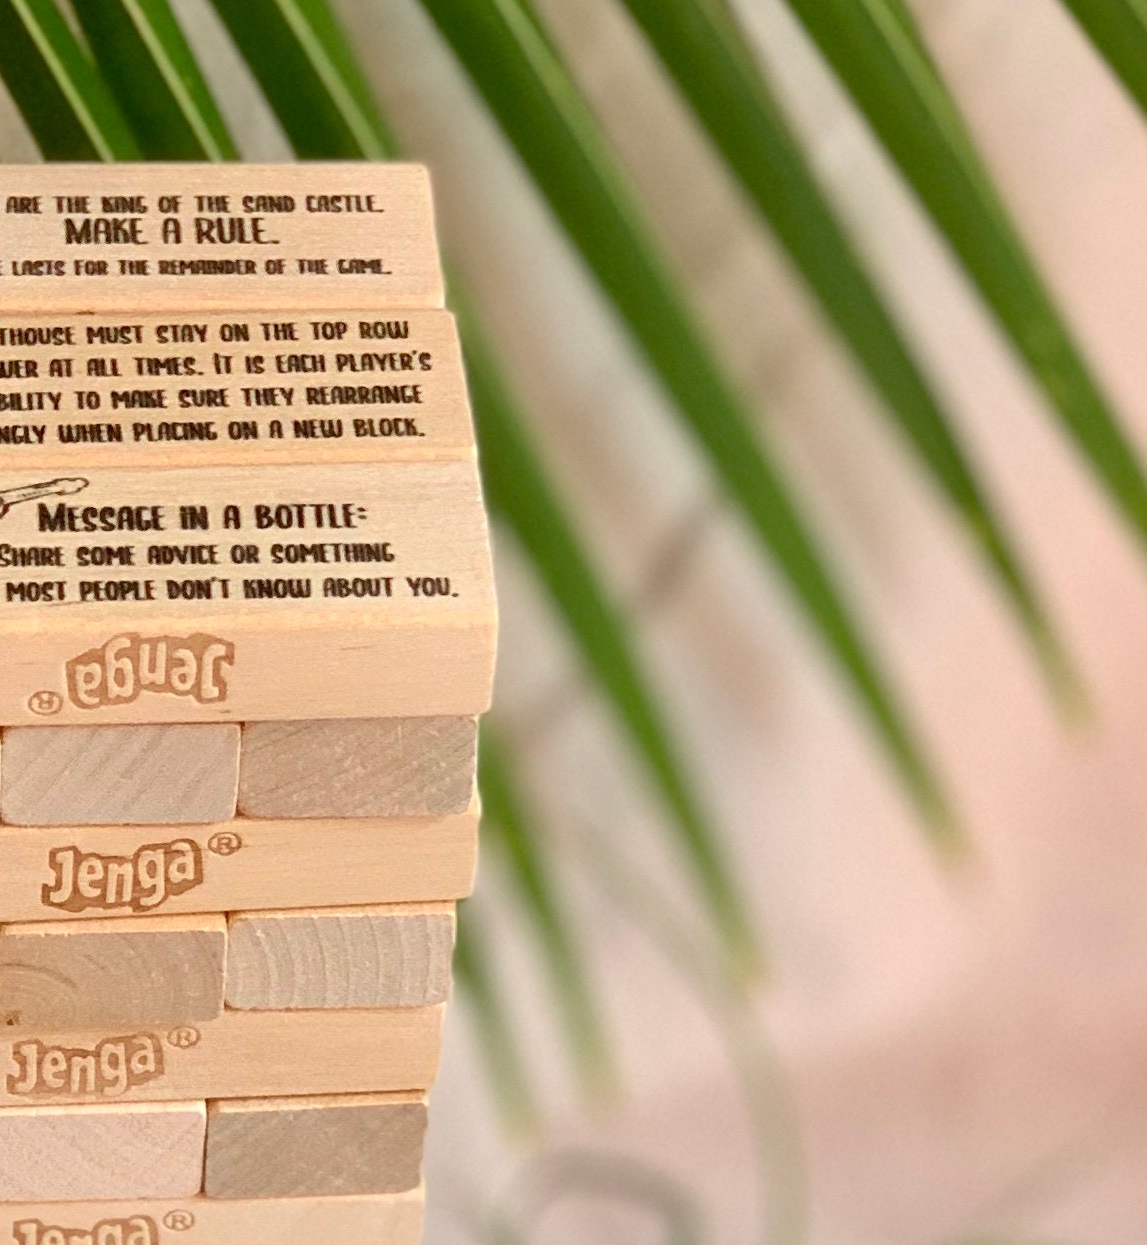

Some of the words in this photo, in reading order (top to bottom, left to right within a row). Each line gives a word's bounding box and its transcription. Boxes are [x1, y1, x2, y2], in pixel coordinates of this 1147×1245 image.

[6, 195, 42, 214] ARE
[54, 195, 90, 214] THE
[100, 195, 148, 214] KING
[157, 195, 182, 214] OF
[194, 195, 230, 213] THE
[241, 195, 296, 213] SAND
[64, 217, 148, 245] MAKE
[162, 217, 182, 245] A
[12, 259, 66, 277] LASTS
[73, 259, 109, 276] FOR
[118, 259, 150, 276] THE
[158, 259, 257, 276] REMAINDER
[264, 259, 285, 276] OF
[296, 258, 329, 276] THE
[86, 325, 143, 345] MUST
[155, 324, 208, 344] STAY
[219, 323, 250, 342] ON
[260, 322, 299, 342] THE
[309, 321, 348, 341] TOP
[358, 320, 409, 340] ROW
[49, 358, 74, 378] AT
[86, 357, 122, 377] ALL
[213, 352, 233, 375] IT
[245, 355, 265, 375] IS
[275, 354, 326, 374] EACH
[73, 390, 101, 410] TO
[110, 389, 168, 410] MAKE
[177, 388, 229, 409] SURE
[240, 387, 294, 407] THEY
[305, 384, 423, 406] REARRANGE
[57, 423, 123, 444] WHEN
[132, 421, 218, 442] PLACING
[227, 420, 259, 441] ON
[268, 419, 284, 439] A
[292, 418, 343, 439] NEW
[37, 502, 166, 533] MESSAGE
[179, 505, 209, 531] IN
[223, 504, 241, 530] A
[76, 545, 135, 567] SOME
[147, 544, 220, 565] ADVICE
[230, 544, 260, 565] OR
[270, 542, 395, 564] SOMETHING
[5, 581, 67, 602] MOST
[79, 579, 157, 602] PEOPLE
[242, 578, 311, 599] KNOW
[322, 577, 394, 598] ABOUT
[66, 632, 234, 709] Jenga
[41, 839, 203, 912] Jenga
[7, 1032, 165, 1096] Jenga
